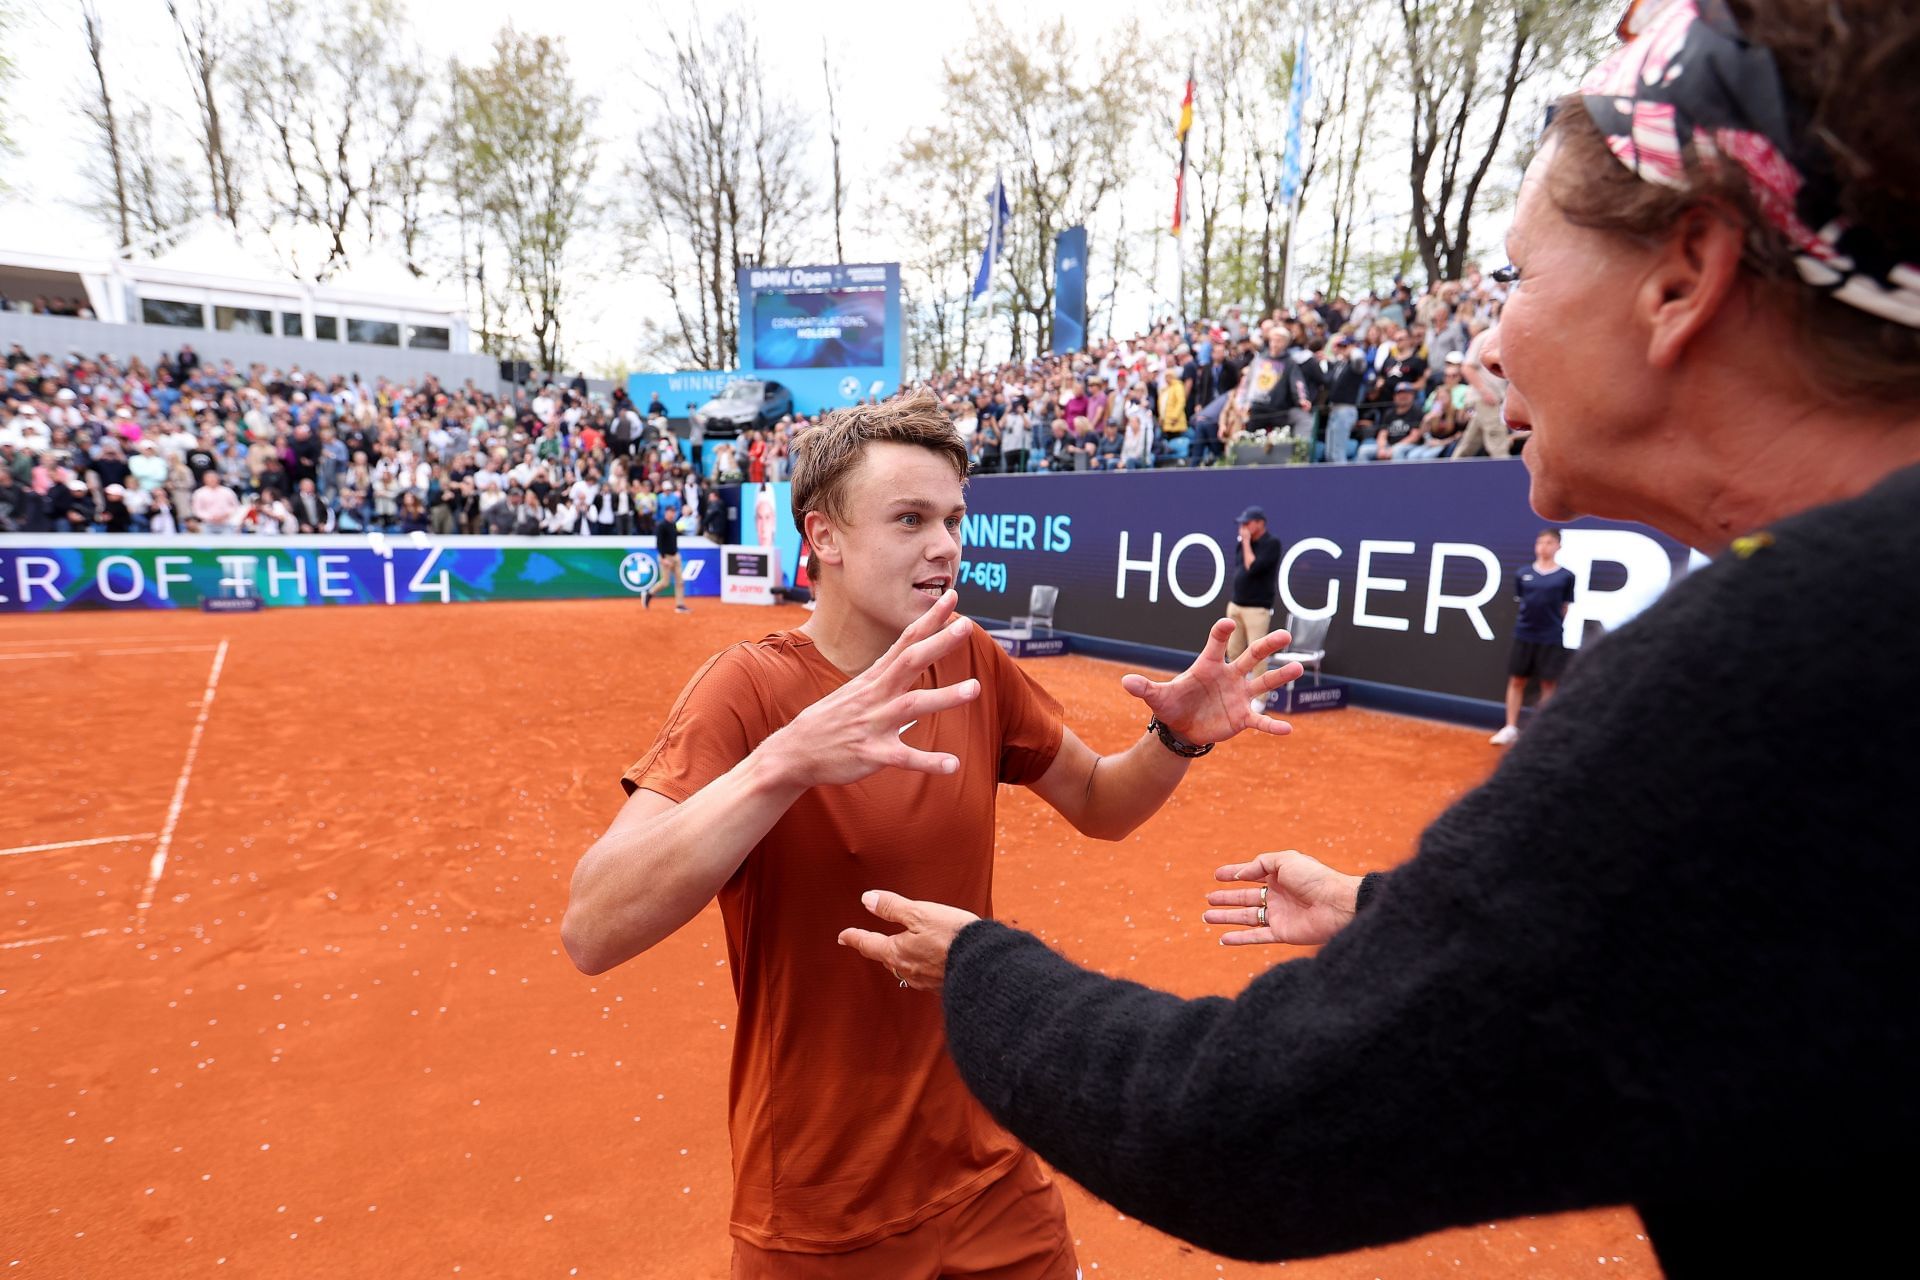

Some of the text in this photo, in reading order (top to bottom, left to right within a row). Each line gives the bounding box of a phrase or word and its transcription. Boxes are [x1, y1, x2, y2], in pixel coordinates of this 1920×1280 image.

[750, 271, 790, 288] BMW
[791, 269, 832, 288] Open
[1043, 515, 1072, 552] IS
[0, 556, 66, 602] R
[96, 555, 193, 602] OF
[216, 555, 354, 599] THE
[1116, 530, 1502, 641] HOGER
